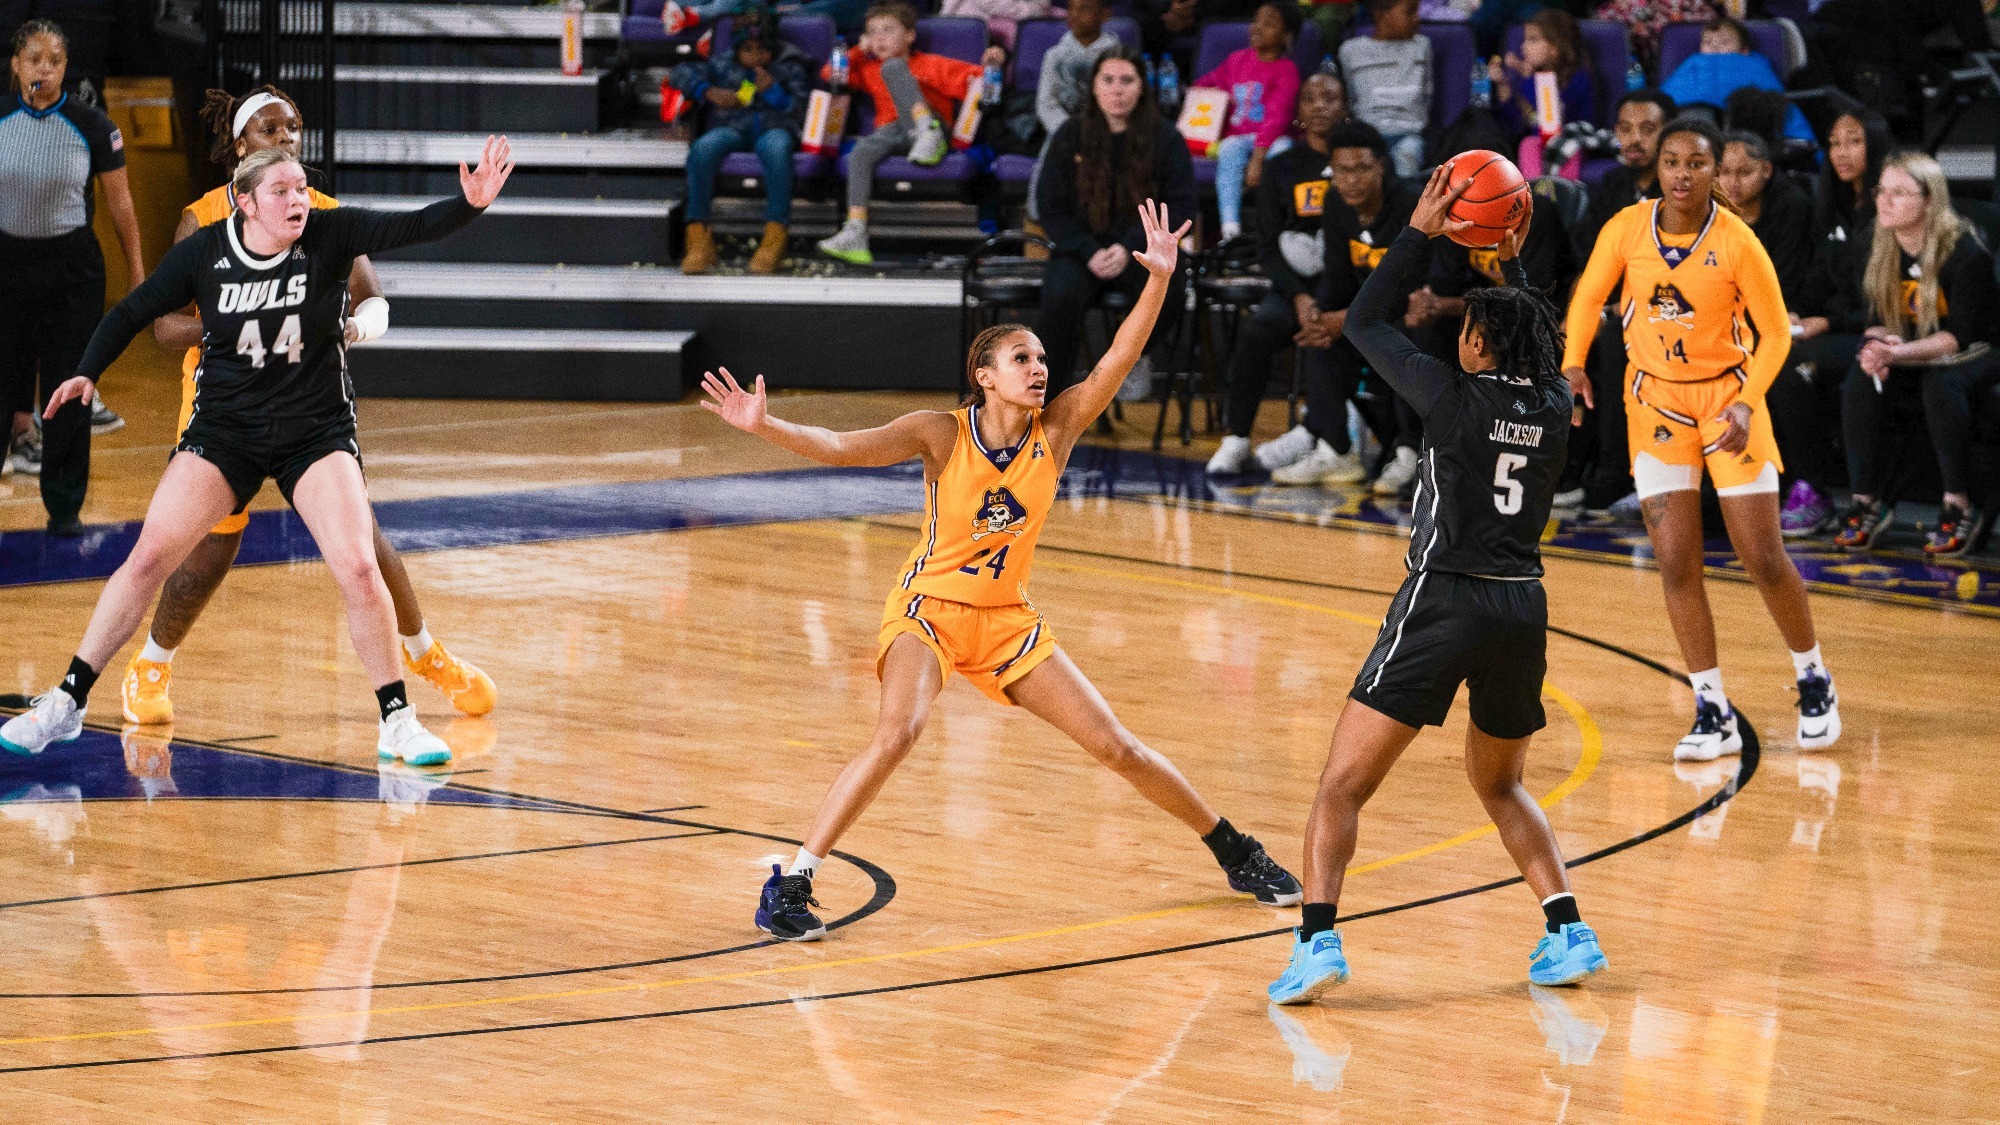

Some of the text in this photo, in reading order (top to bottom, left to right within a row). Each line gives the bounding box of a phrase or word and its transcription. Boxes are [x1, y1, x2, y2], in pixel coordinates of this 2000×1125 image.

[218, 273, 307, 314] OWLS
[236, 313, 305, 369] 44
[1659, 334, 1689, 364] 14
[1489, 418, 1543, 448] JACKSON
[988, 493, 1006, 504] ECU
[1493, 452, 1528, 515] 5
